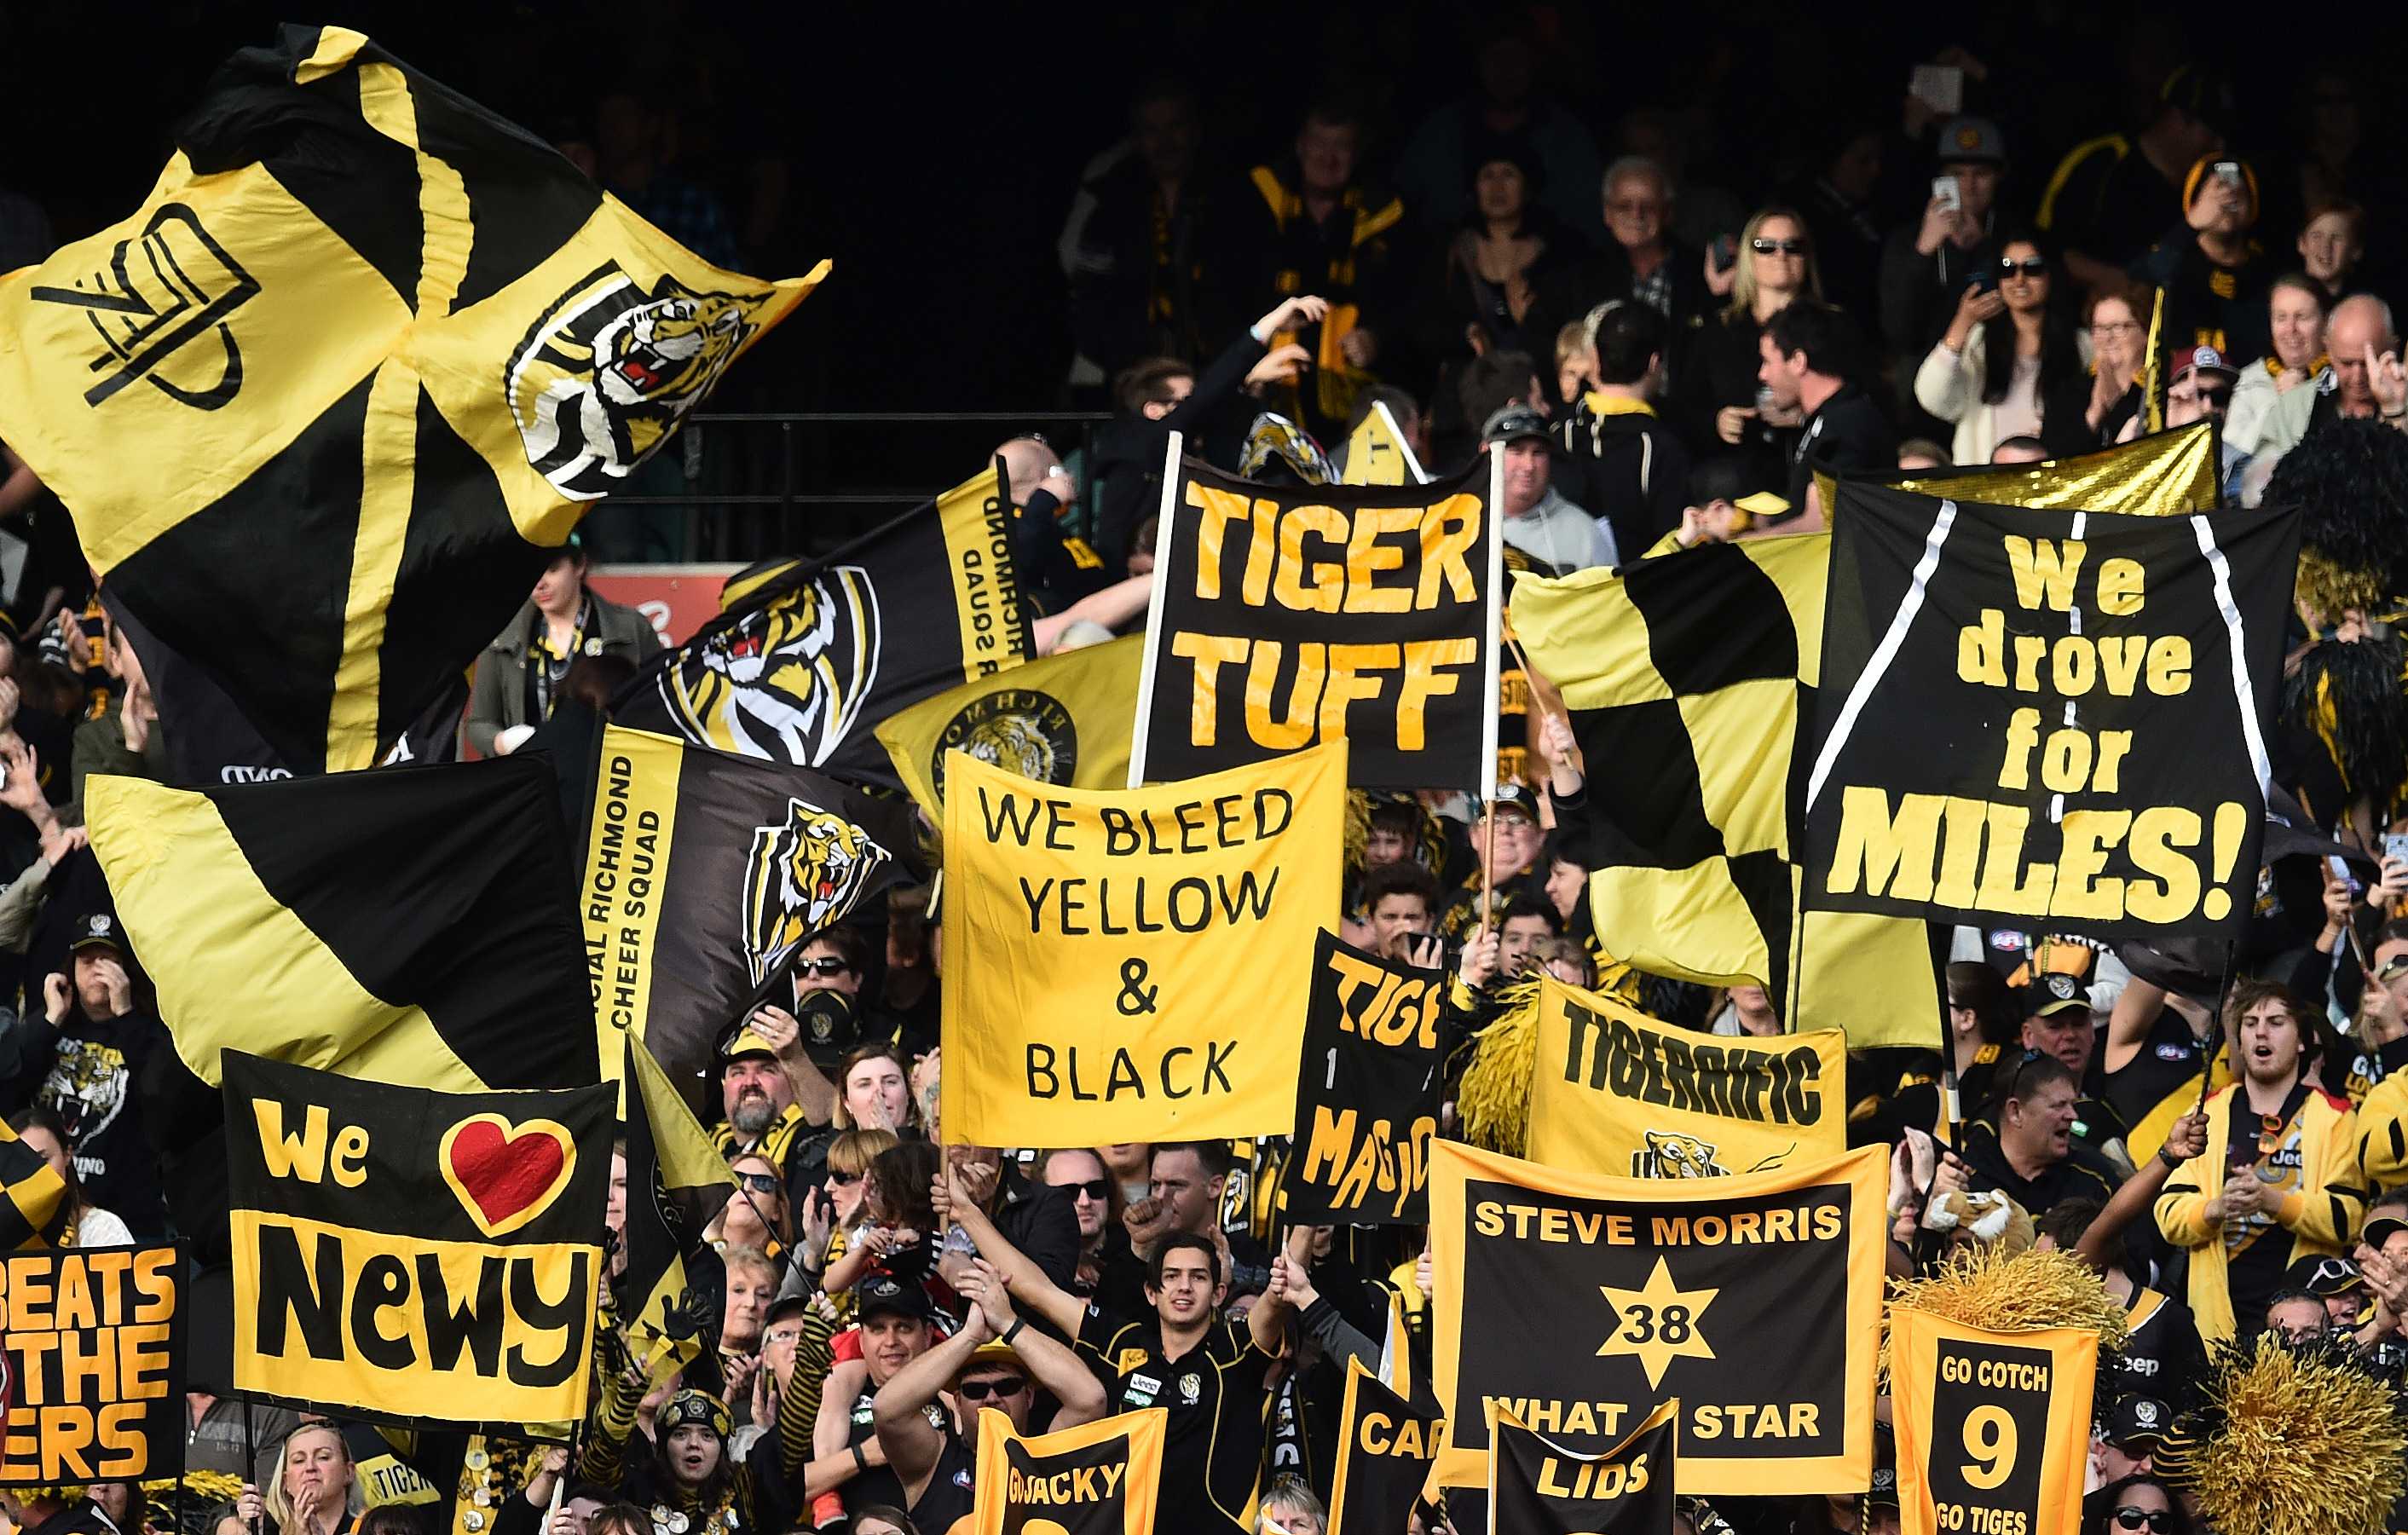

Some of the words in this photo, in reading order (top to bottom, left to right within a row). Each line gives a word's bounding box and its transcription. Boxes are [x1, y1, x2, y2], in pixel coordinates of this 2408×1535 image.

[1186, 480, 1482, 613] TIGER
[2005, 535, 2145, 615] We
[1172, 631, 1476, 750] TUFF
[1957, 609, 2191, 696] drove
[1998, 707, 2132, 793] for
[588, 756, 632, 923] RICHMOND
[979, 787, 1076, 851] WE
[1100, 788, 1292, 856] BLEED
[1827, 786, 2246, 923] MILES!
[624, 810, 659, 919] SQUAD
[1020, 866, 1279, 935] YELLOW
[611, 929, 641, 1030] CHEER
[1116, 958, 1158, 1016] &
[1328, 949, 1441, 1049] TIGE
[1025, 1041, 1238, 1101] BLACK
[1563, 999, 1822, 1126] TIGERRIFIC
[252, 1098, 369, 1187] We
[1474, 1201, 1636, 1245] STEVE
[1651, 1204, 1842, 1246] MORRIS
[0, 1248, 176, 1331] EATS
[1623, 1304, 1691, 1345] 38
[5, 1324, 170, 1405] THE
[1942, 1356, 1972, 1384] GO
[1978, 1360, 2047, 1391] COTCH
[1481, 1395, 1628, 1436] WHAT
[1692, 1403, 1821, 1439] STAR
[1960, 1405, 2018, 1490] 9
[1024, 1463, 1126, 1505] JACKY
[1536, 1452, 1649, 1499] LIDS
[1936, 1503, 1964, 1532] GO
[1970, 1506, 2027, 1535] TIGES
